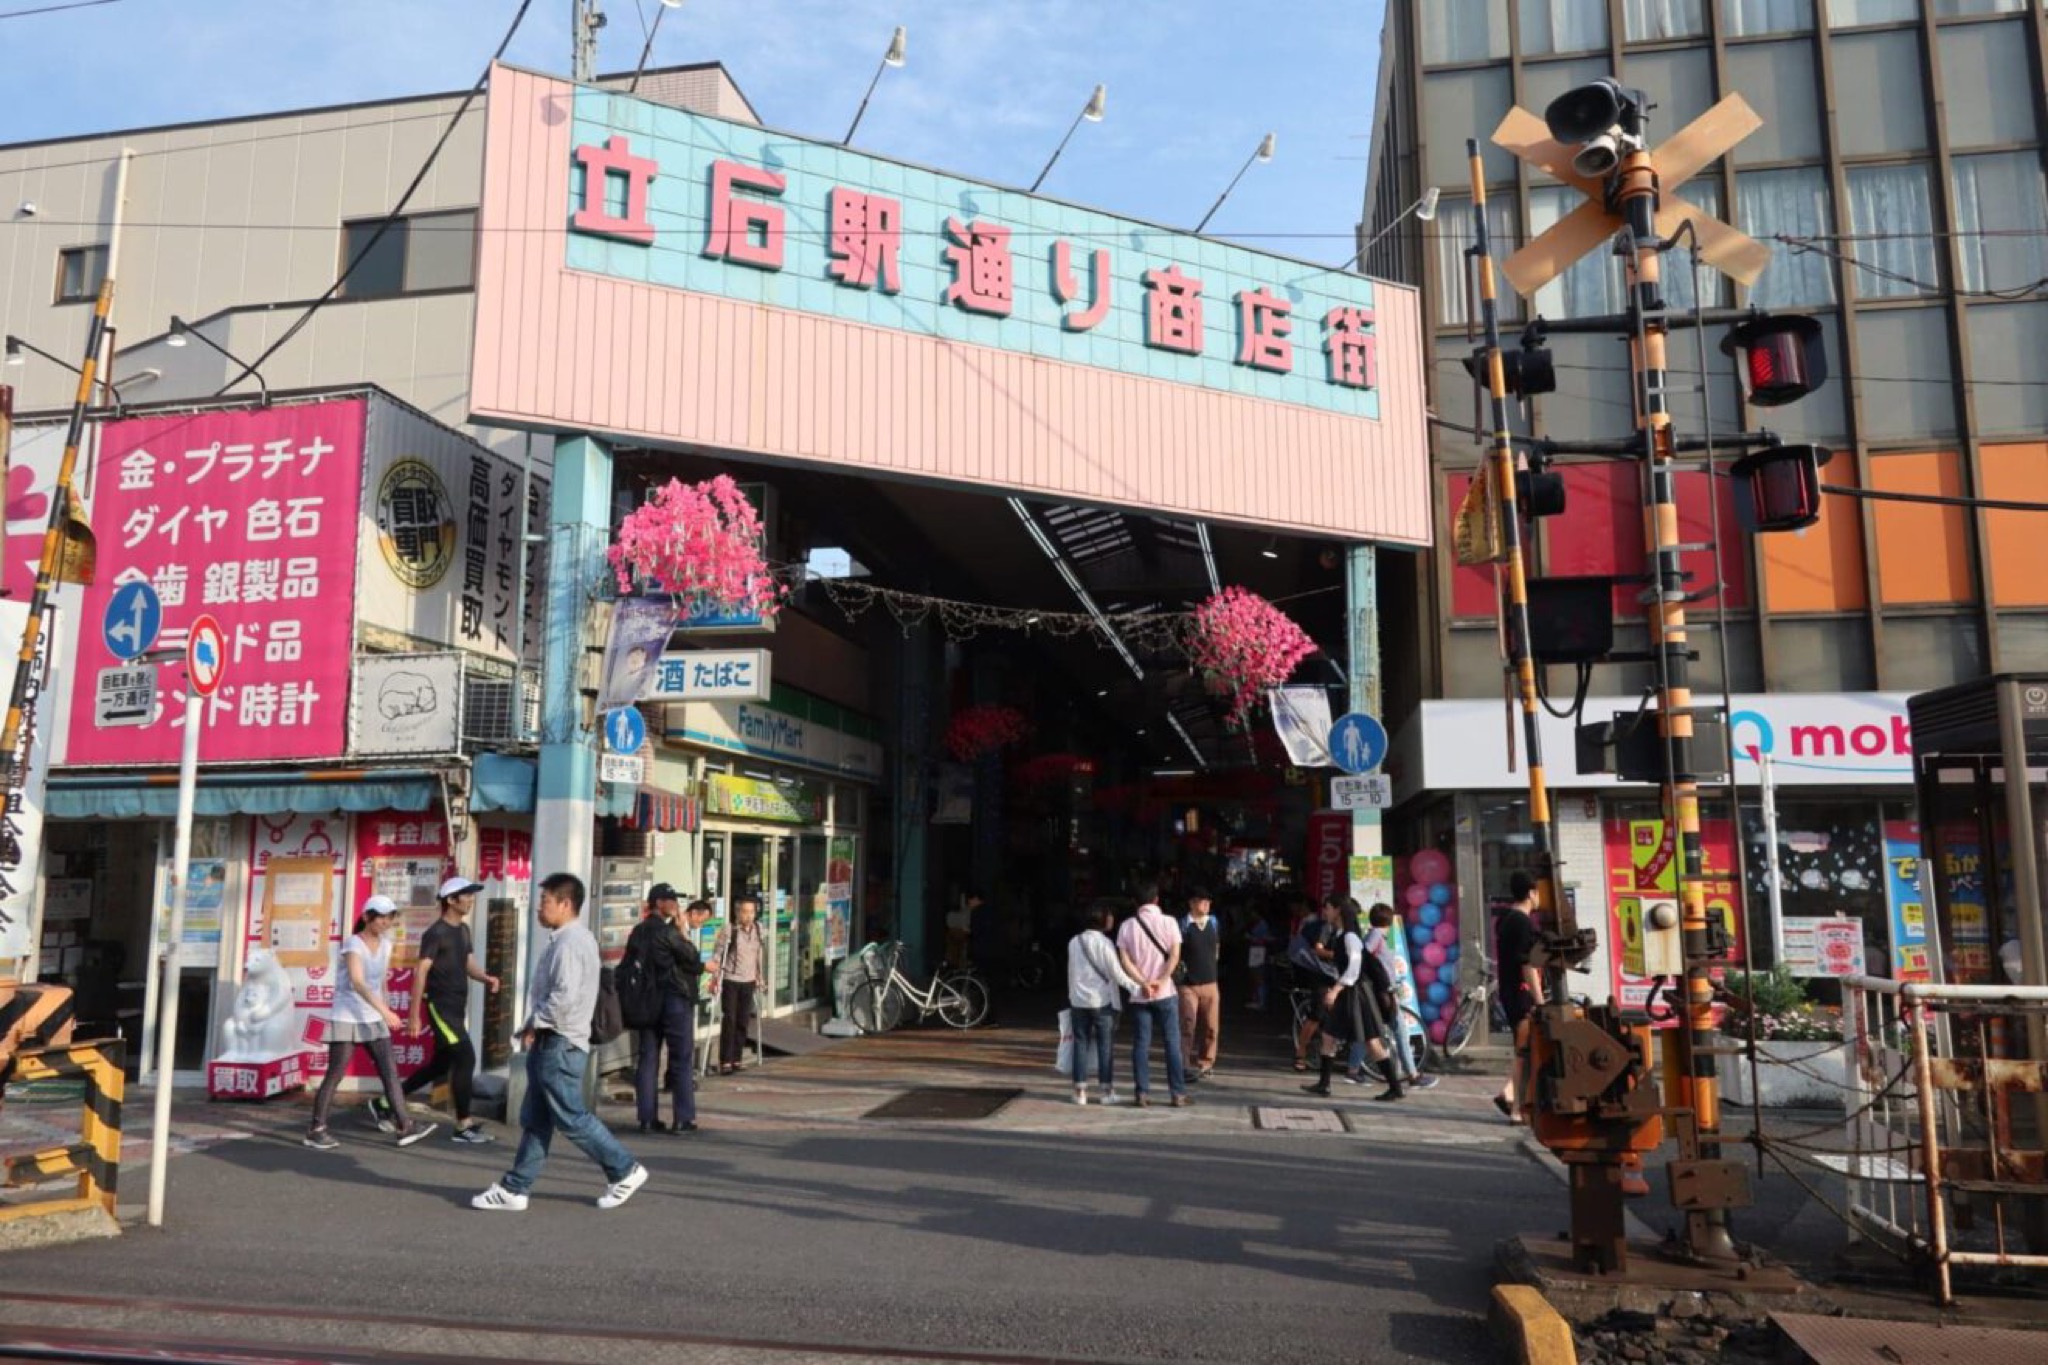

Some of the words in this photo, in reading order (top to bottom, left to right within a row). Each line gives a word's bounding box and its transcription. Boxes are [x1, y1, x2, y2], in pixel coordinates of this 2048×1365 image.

[572, 134, 1378, 389] 立石駅通り商店街
[119, 435, 335, 490] 金・プラチナ
[122, 504, 229, 548] ダイヤ
[247, 497, 324, 541] 色石
[460, 455, 492, 642] 高価買取
[494, 472, 518, 651] ダイヤモンド
[203, 557, 319, 604] 銀製品
[655, 659, 686, 693] 酒
[693, 661, 752, 688] たばこ
[738, 703, 804, 750] FamilyMart
[213, 1066, 259, 1093] 買取
